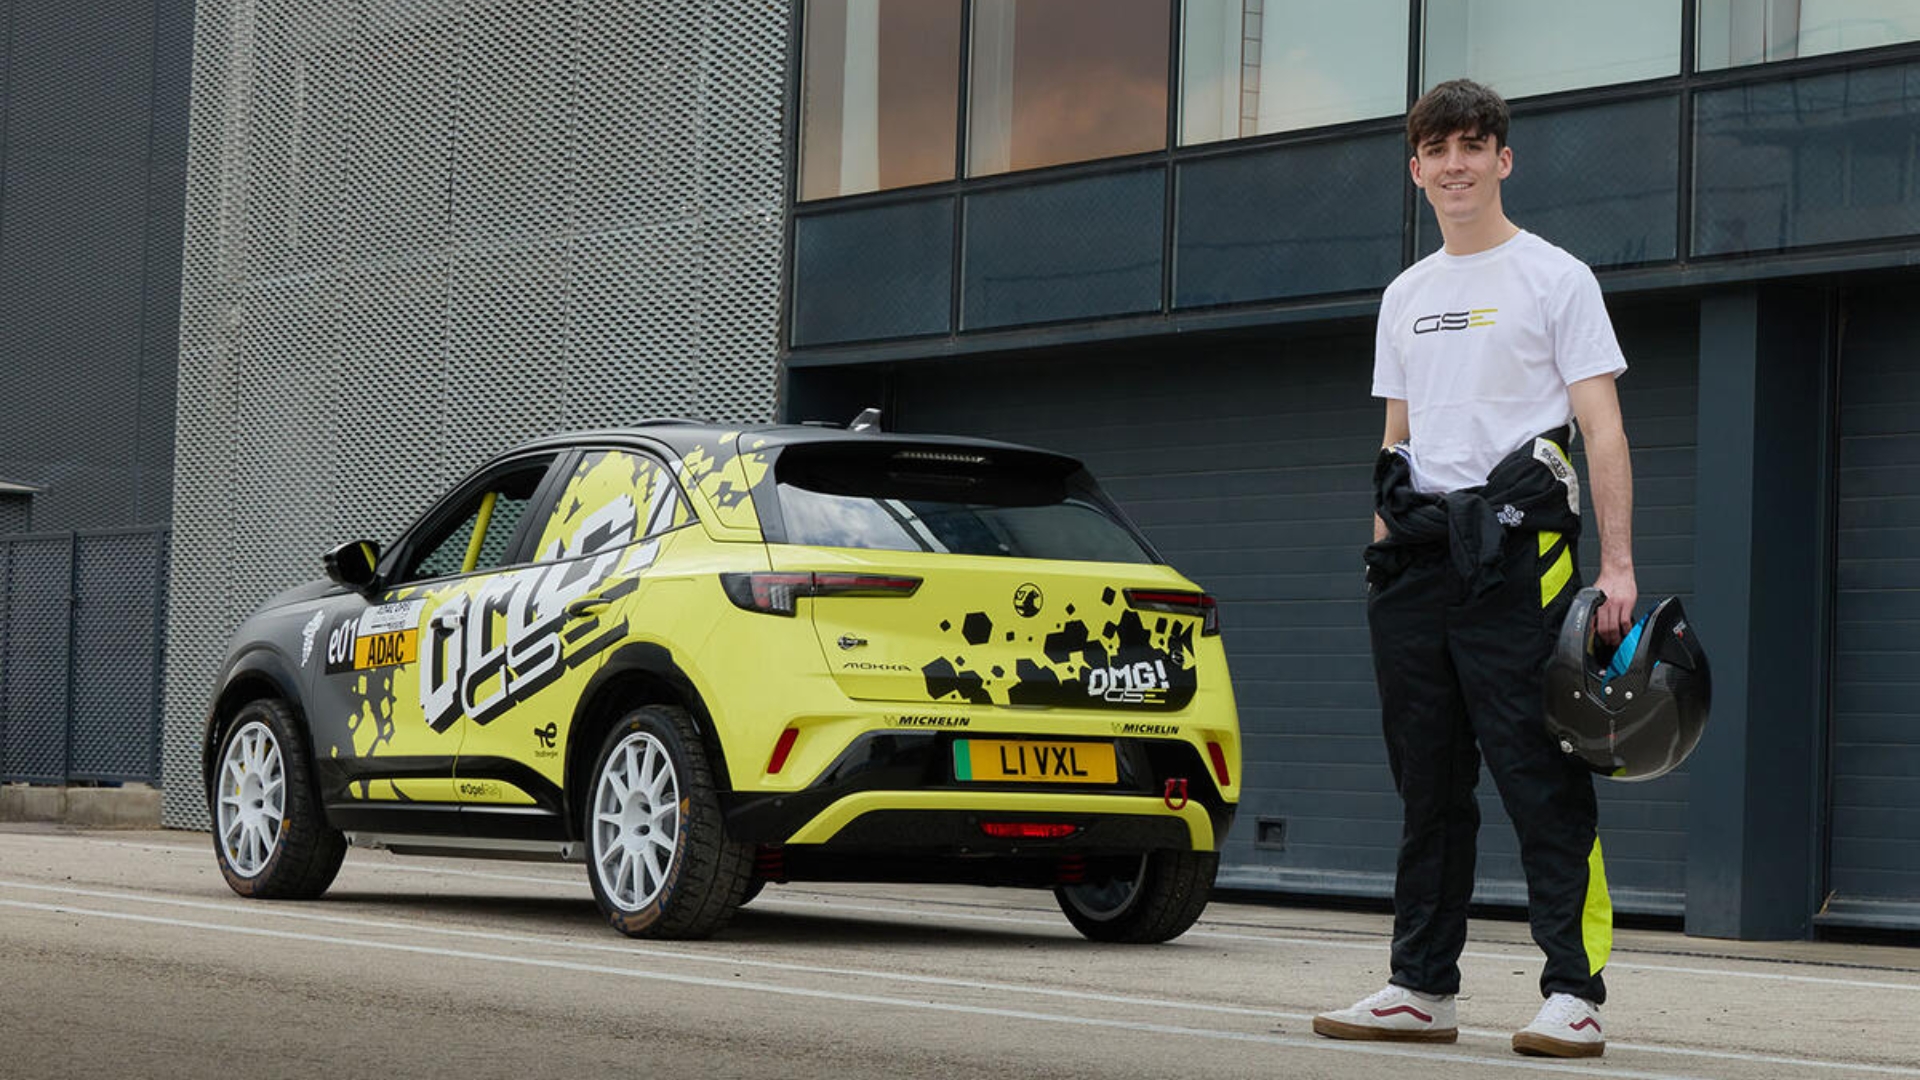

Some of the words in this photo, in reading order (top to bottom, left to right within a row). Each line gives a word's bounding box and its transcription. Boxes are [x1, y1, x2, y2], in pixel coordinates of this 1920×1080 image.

[1412, 308, 1498, 335] GSE
[327, 617, 359, 665] e01
[366, 632, 405, 667] ADAC
[843, 662, 911, 671] MOKKA
[1087, 659, 1170, 697] OMG!
[898, 715, 970, 727] MICHELIN
[1122, 723, 1180, 735] MICHELIN
[1033, 747, 1088, 776] VXL
